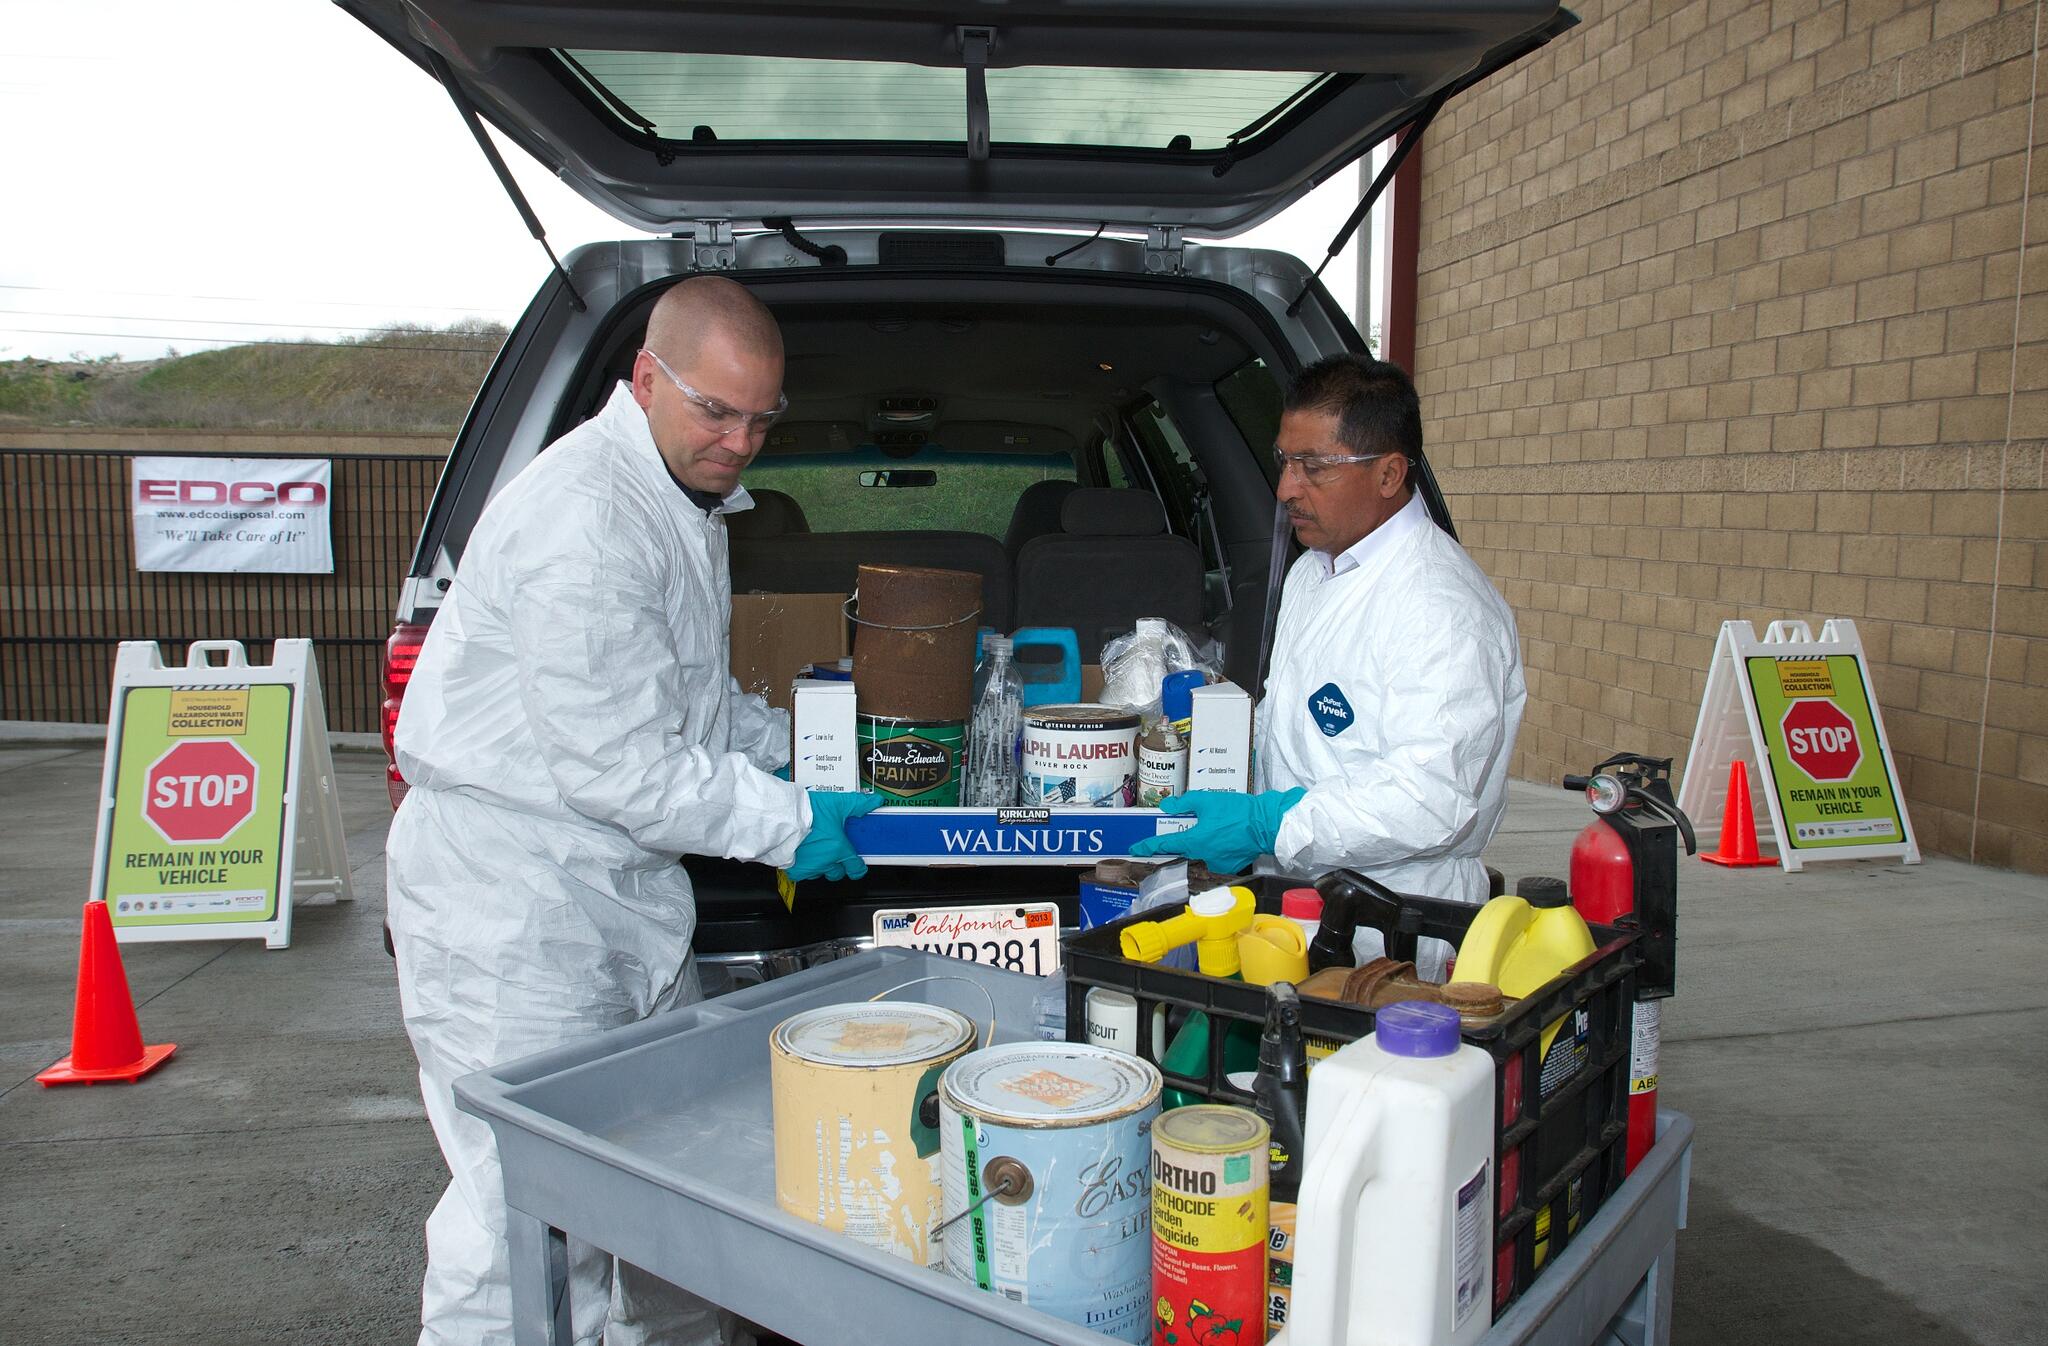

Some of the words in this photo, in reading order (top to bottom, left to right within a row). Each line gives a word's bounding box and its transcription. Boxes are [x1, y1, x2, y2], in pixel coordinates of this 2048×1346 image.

[138, 479, 327, 508] EDCO
[156, 510, 306, 521] www.edcodisposal.com
[202, 530, 232, 542] Take
[236, 530, 265, 543] Care
[270, 531, 284, 545] of
[1784, 683, 1832, 691] COLLECTION
[1316, 700, 1347, 719] Tyvek
[171, 719, 243, 728] COLLECTION
[1056, 741, 1129, 760] LAUREN
[1790, 727, 1852, 755] STOP
[867, 748, 946, 765] Dunn-Edwards
[1034, 760, 1058, 769] RIVER
[876, 766, 938, 781] PAINTS
[153, 774, 249, 809] STOP
[1789, 788, 1836, 803] REMAIN
[1838, 787, 1850, 800] IN
[1850, 786, 1882, 799] YOUR
[1000, 810, 1049, 818] KIRKLAND
[1816, 801, 1863, 815] VEHICLE
[940, 829, 1103, 853] WALNUTS
[125, 851, 194, 869] REMAIN
[200, 850, 218, 866] IN
[220, 849, 263, 866] YOUR
[159, 868, 228, 886] VEHICLE
[883, 919, 909, 930] MAR
[913, 913, 1025, 940] California
[1030, 913, 1049, 923] 2013
[967, 1149, 979, 1197] SEARS
[1153, 1148, 1216, 1196] ORTHO
[1153, 1183, 1216, 1217] ORTHOCIDE
[1153, 1199, 1183, 1228] Garden
[973, 1217, 986, 1264] SEARS
[1153, 1214, 1199, 1248] Fungicide
[1086, 1291, 1150, 1325] Interior
